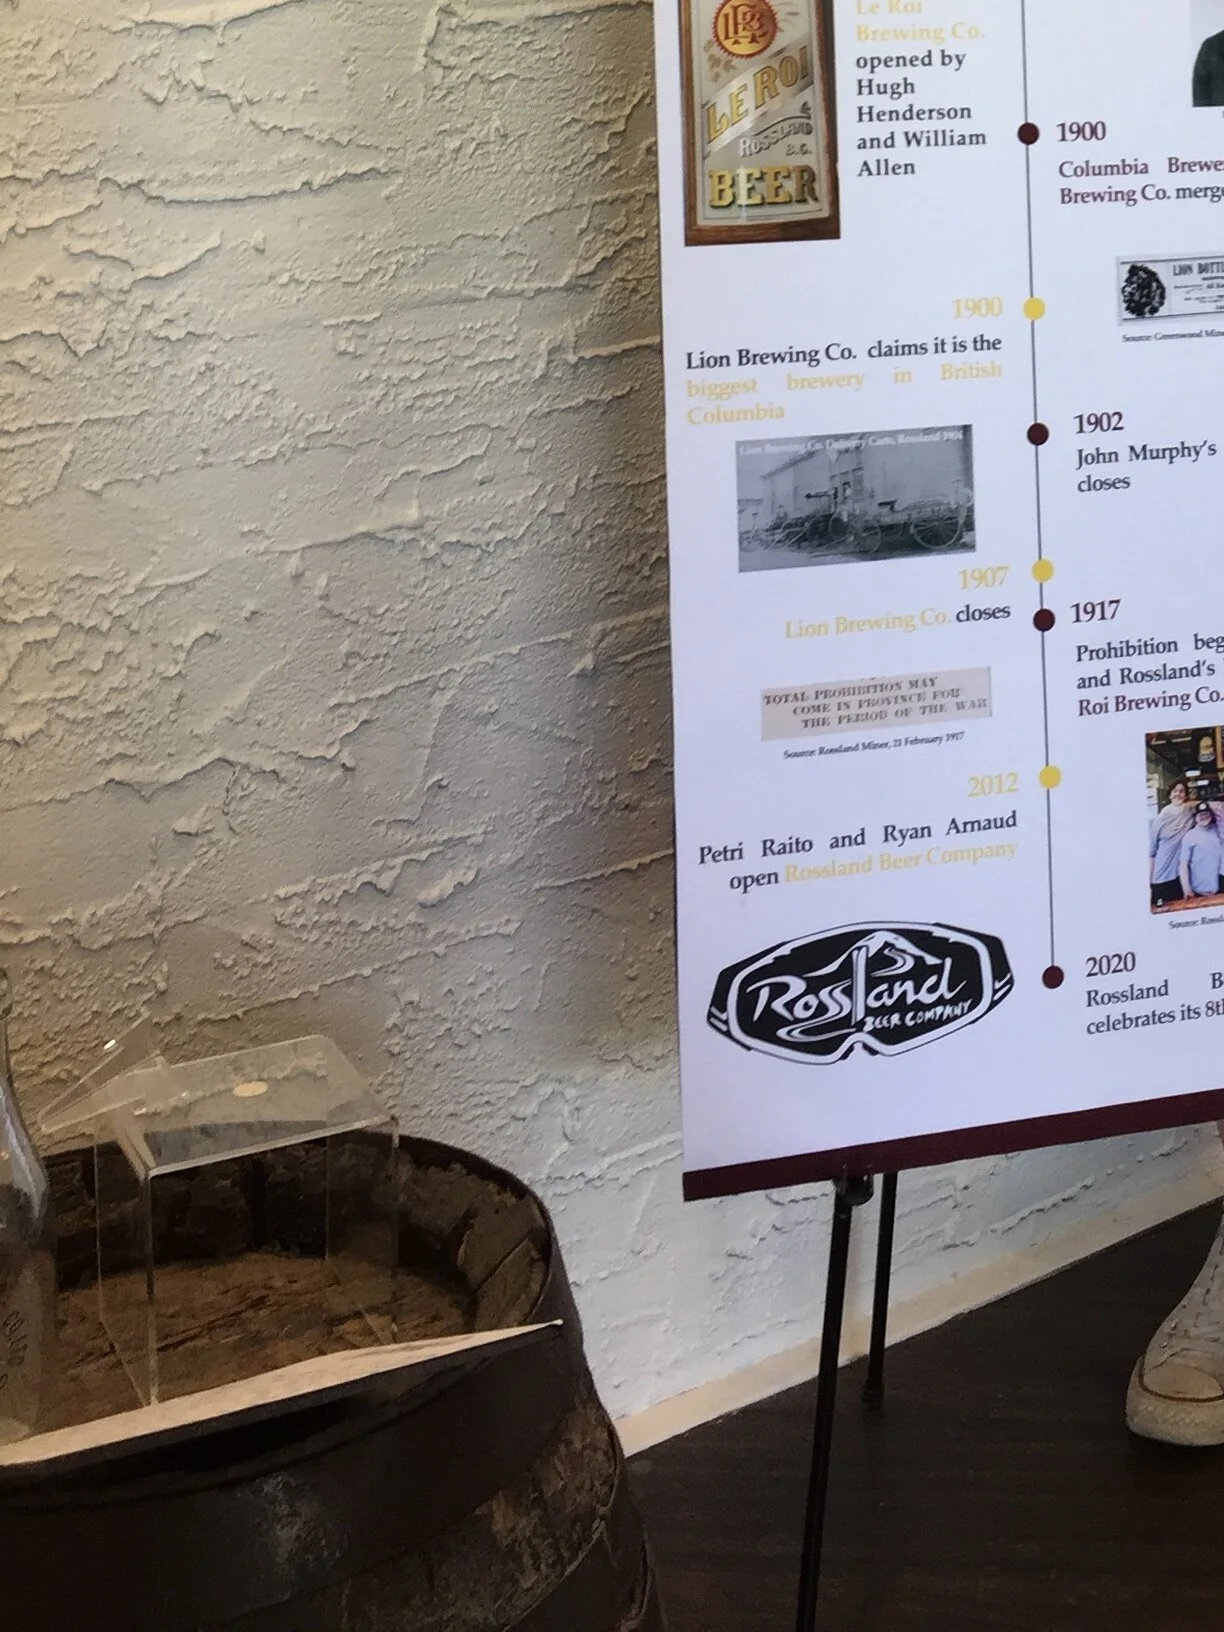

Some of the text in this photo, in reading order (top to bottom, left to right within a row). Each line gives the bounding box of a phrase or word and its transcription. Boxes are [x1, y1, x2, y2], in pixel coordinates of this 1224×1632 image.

[856, 49, 966, 74] opened by
[857, 77, 915, 100] Hugh
[857, 104, 971, 123] Henderson
[857, 129, 986, 150] and William
[1057, 121, 1106, 142] 1900
[858, 159, 915, 177] Allen
[1059, 158, 1149, 178] Columbia
[1060, 186, 1137, 207] Brewing
[1141, 184, 1171, 201] Co.
[952, 297, 1003, 319] 1900
[1074, 411, 1124, 434] 1902
[1071, 599, 1120, 623] 1917
[968, 772, 1019, 798] 2012
[1086, 952, 1136, 977] 2020
[746, 945, 967, 1028] Rossland
[1086, 979, 1169, 1007] Rossland
[863, 998, 973, 1032] BEER COMPANY
[1087, 1010, 1176, 1034] celebrates
[1180, 1004, 1201, 1021] its
